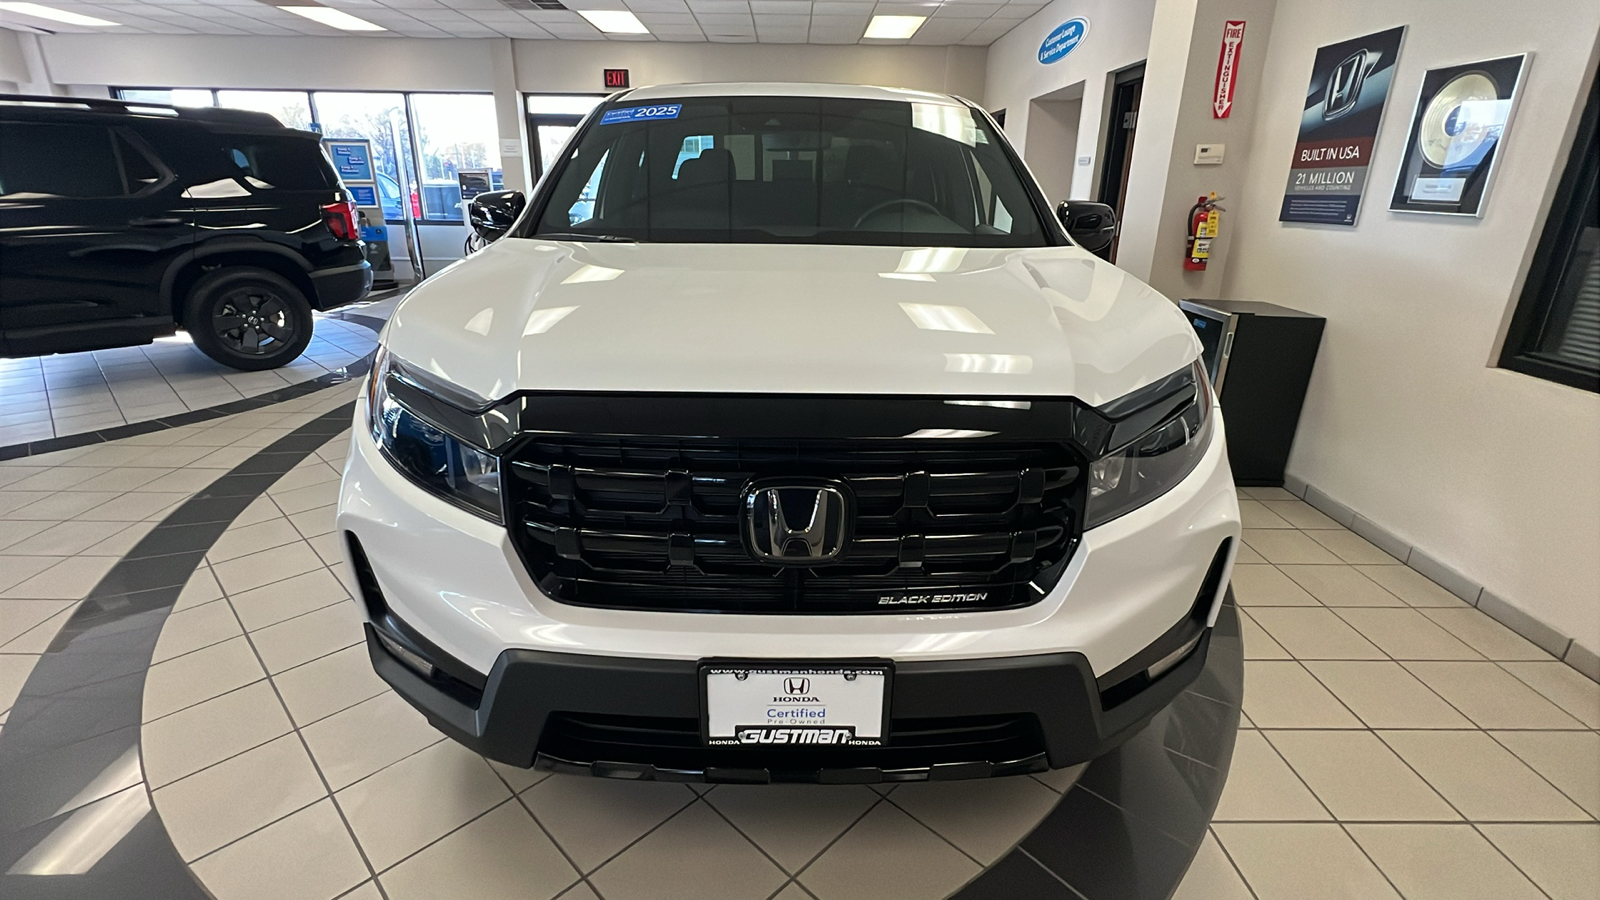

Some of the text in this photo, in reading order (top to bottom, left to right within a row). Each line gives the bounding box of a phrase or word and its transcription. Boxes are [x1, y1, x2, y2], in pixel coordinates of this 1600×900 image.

[1226, 28, 1242, 38] FIRE
[606, 71, 626, 86] EXIT
[1218, 41, 1234, 110] EXTINGUISHER
[634, 106, 678, 118] 2025
[1301, 146, 1360, 162] BUILT IN USA
[1295, 171, 1355, 185] 21 MILLION
[878, 592, 988, 604] BLACK EDITION
[767, 708, 826, 718] Certified
